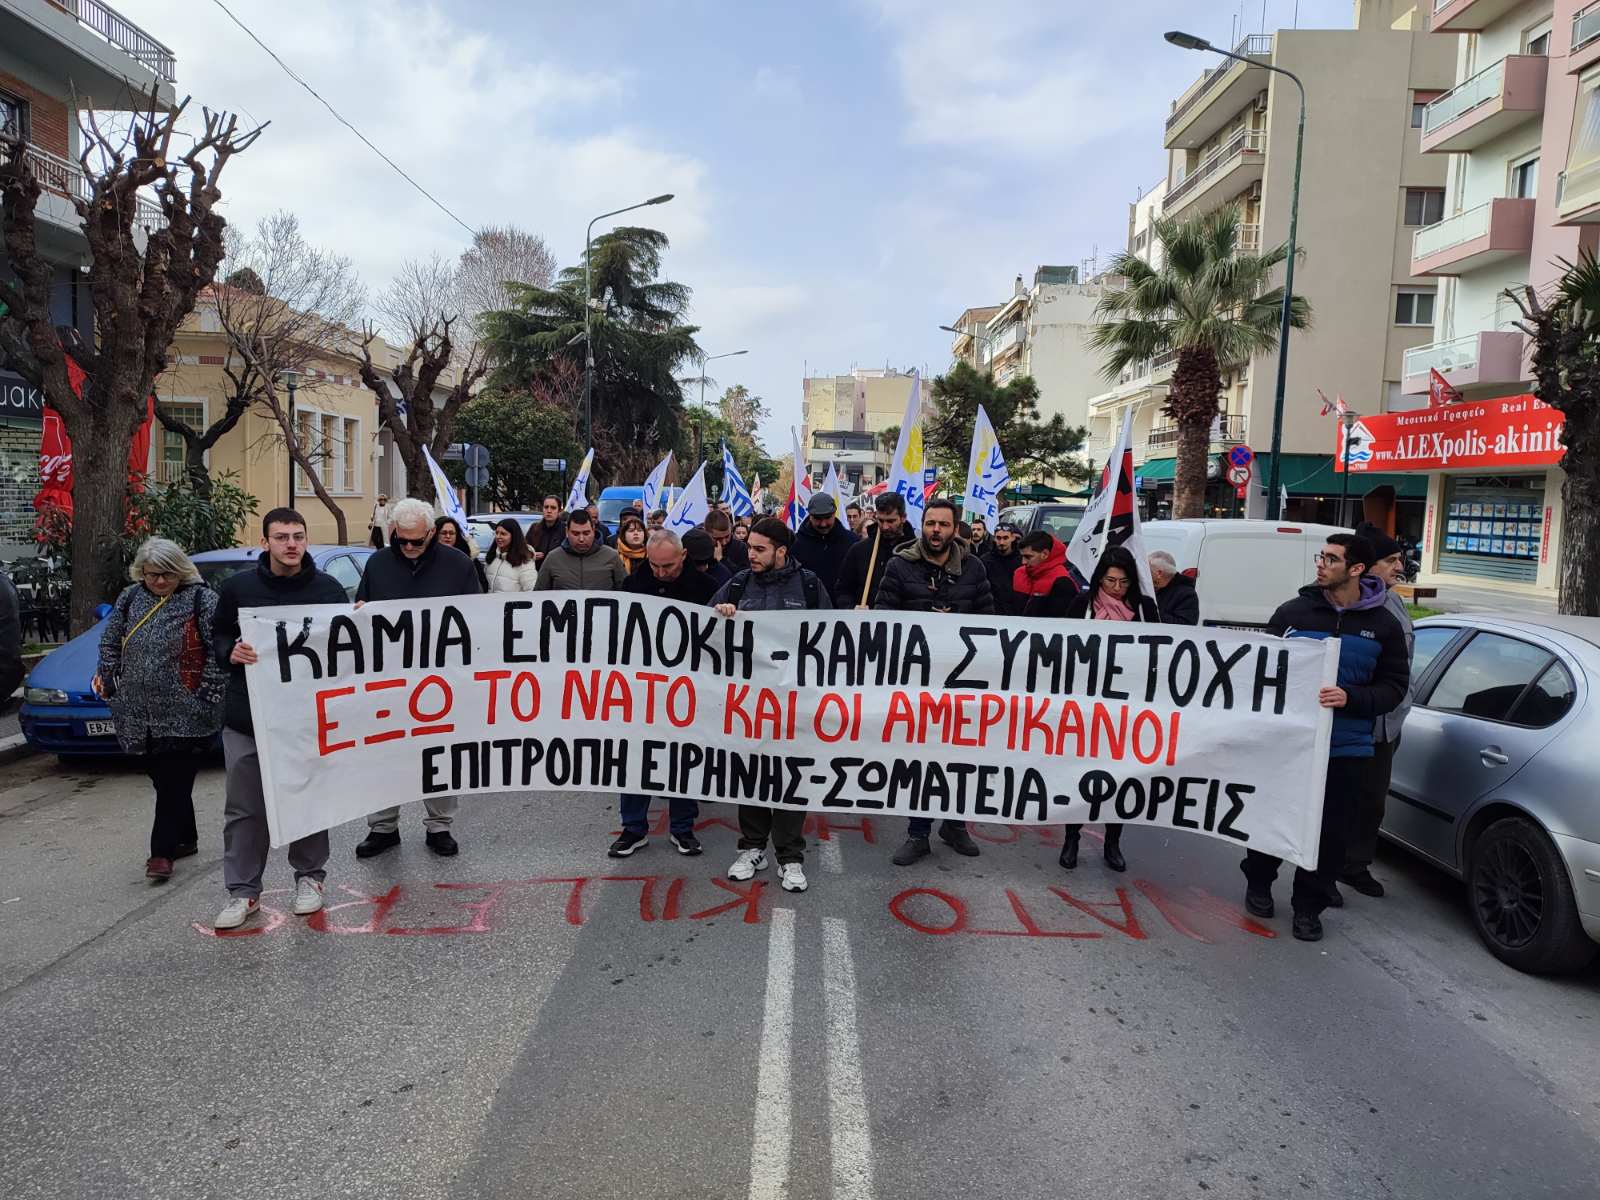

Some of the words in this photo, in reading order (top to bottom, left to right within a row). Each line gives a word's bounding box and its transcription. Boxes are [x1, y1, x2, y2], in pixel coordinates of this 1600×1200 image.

[1443, 406, 1485, 422] Γραφείο
[1502, 400, 1527, 413] Real
[1533, 398, 1552, 410] Es
[1375, 422, 1568, 464] www.ALEXpolis-akinit
[276, 605, 472, 683] ΚΑΜΙΑ
[503, 598, 755, 680] ΕΜΠΛΟΚΗ
[943, 626, 1289, 715] ΣΥΜΜΕΤΟΧΗ
[89, 722, 114, 734] EBZ
[315, 674, 454, 757] ΕΞΩ
[474, 670, 541, 725] ΤΟ
[561, 670, 697, 728] ΝΑΤΟ
[723, 683, 798, 740] ΚΑΙ
[813, 692, 862, 744] ΟΙ
[881, 691, 1181, 767] ΑΜΕΡΙΚΑΝΟΙ
[422, 737, 629, 795] ΕΠΙΤΡΟΠΗ
